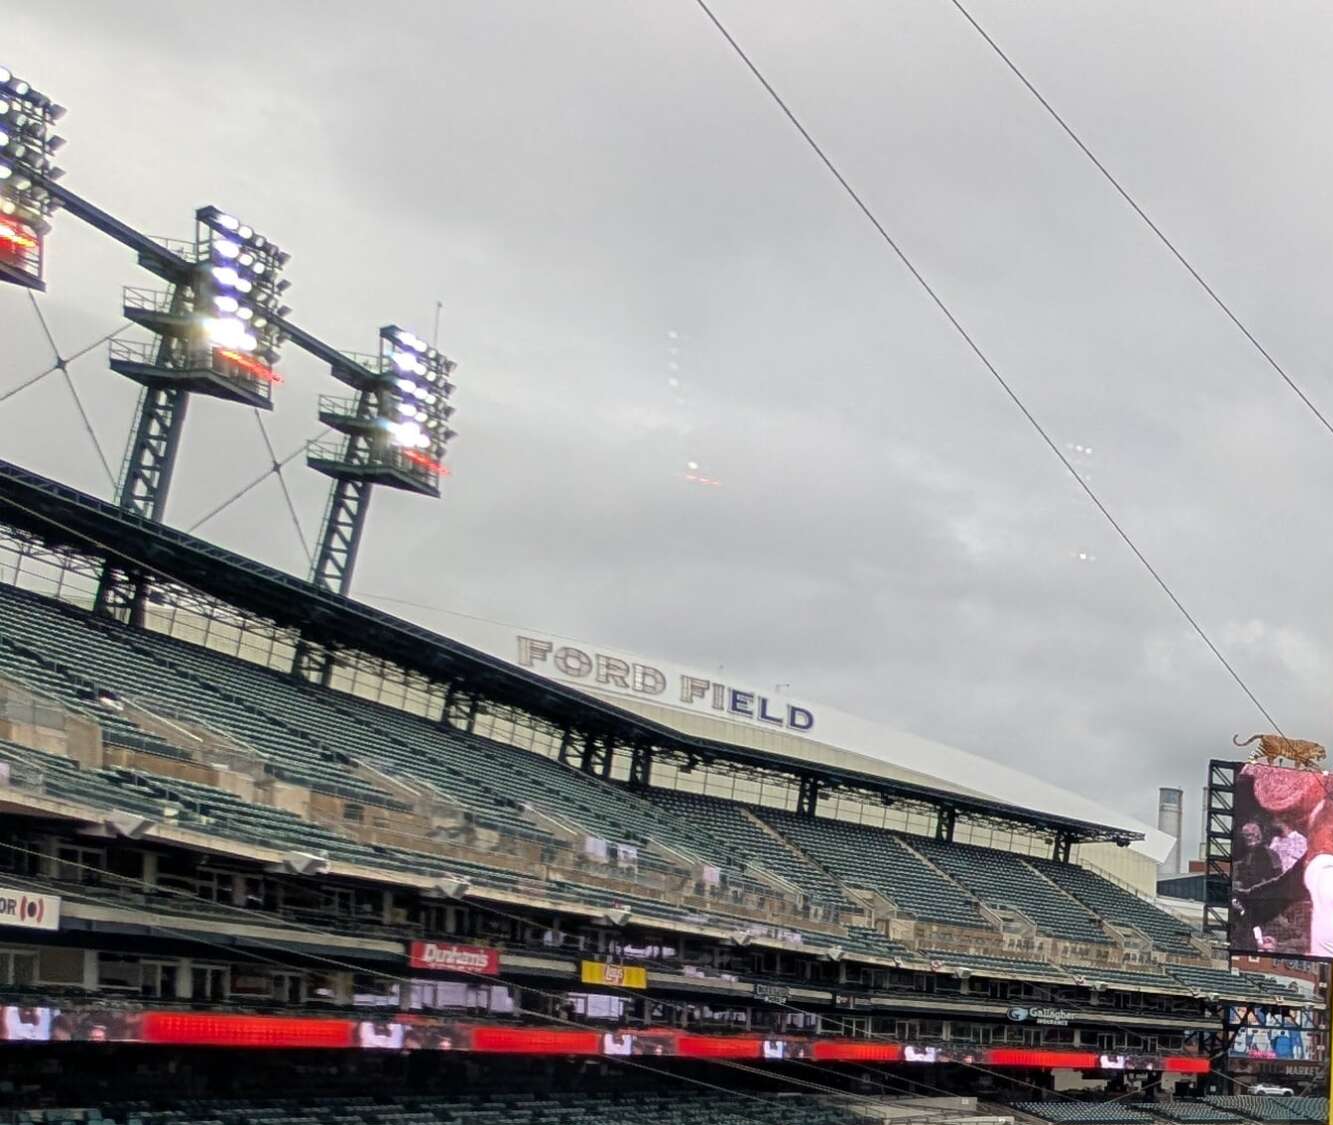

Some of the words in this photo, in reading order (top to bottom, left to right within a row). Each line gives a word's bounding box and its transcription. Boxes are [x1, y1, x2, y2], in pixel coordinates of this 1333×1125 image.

[517, 635, 666, 695] FORD
[680, 674, 815, 731] FIELD
[425, 943, 489, 968] Dunham's
[1029, 1007, 1076, 1021] Gallagher
